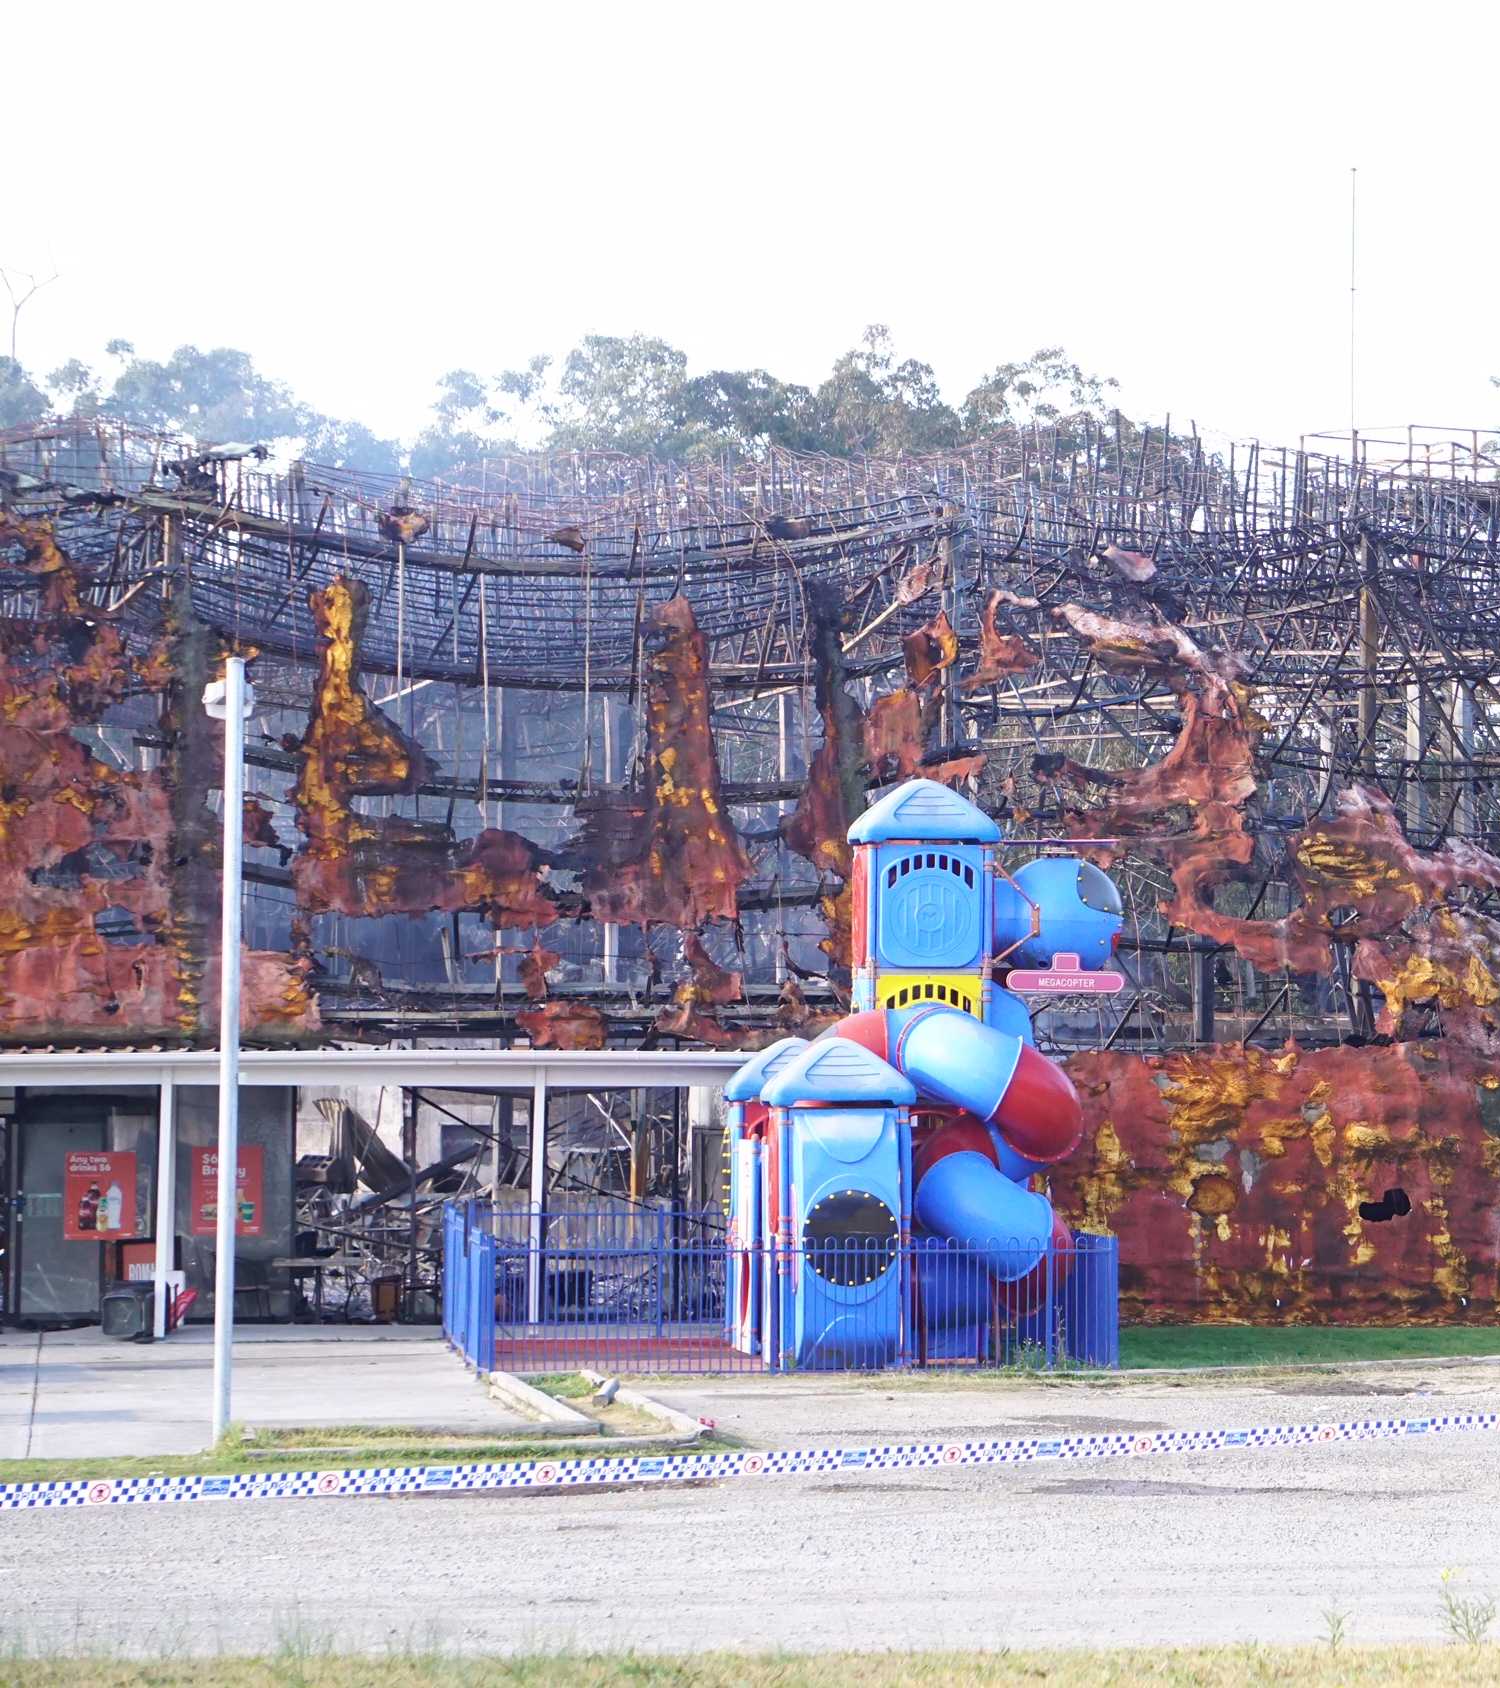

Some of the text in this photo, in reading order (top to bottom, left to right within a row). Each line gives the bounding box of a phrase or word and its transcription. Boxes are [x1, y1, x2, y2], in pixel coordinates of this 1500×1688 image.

[1038, 977, 1095, 988] MEGACOPTER
[70, 1155, 87, 1164] Any
[70, 1163, 97, 1172] drinks
